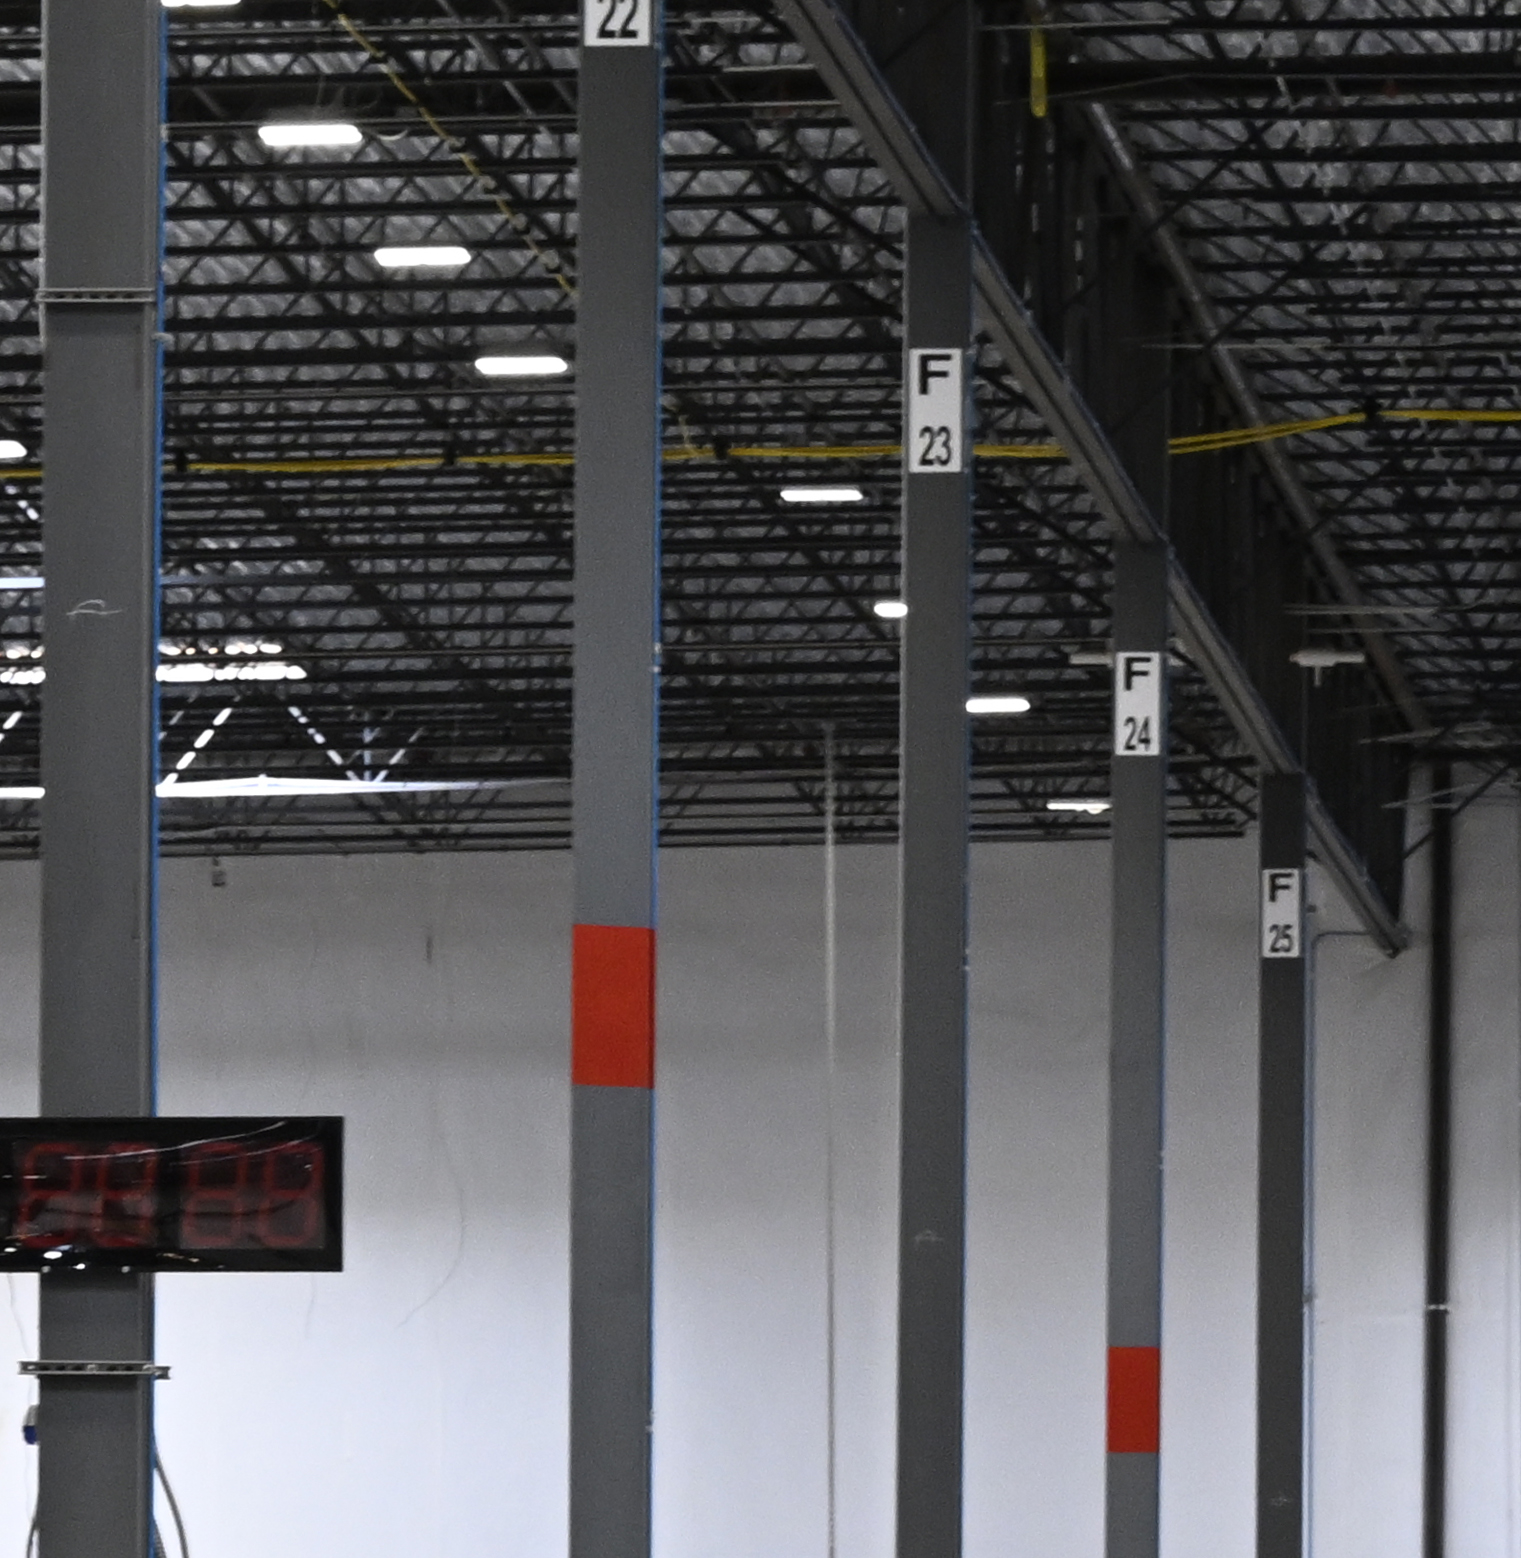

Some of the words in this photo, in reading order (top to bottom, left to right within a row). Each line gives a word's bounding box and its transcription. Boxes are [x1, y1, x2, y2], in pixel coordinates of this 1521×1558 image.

[597, 0, 639, 38] 22
[919, 353, 952, 395] F
[919, 425, 951, 466] 23
[1124, 657, 1152, 691] F
[1123, 716, 1151, 752] 24
[1269, 872, 1294, 902] F
[1269, 924, 1294, 953] 25
